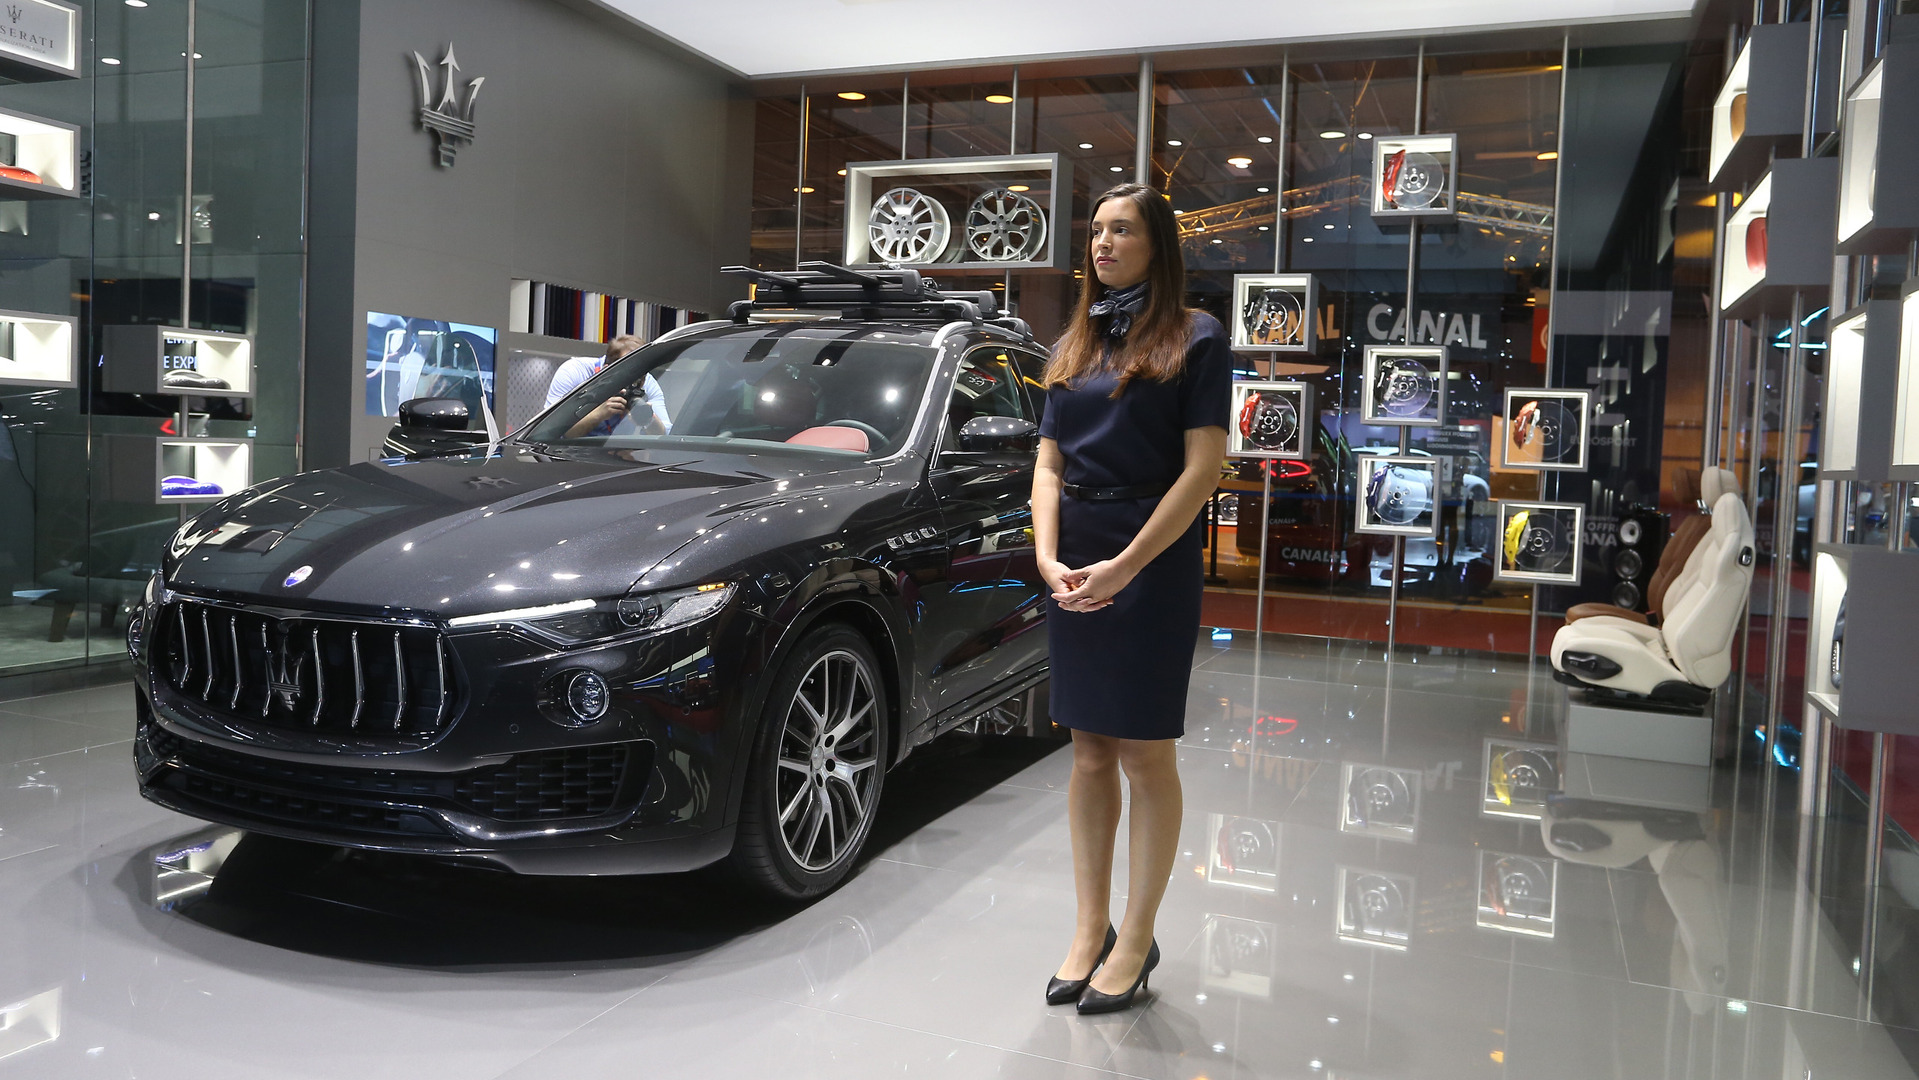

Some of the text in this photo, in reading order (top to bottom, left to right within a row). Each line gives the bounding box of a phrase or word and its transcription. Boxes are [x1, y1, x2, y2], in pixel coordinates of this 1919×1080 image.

[1367, 303, 1487, 349] CANAL
[1570, 435, 1637, 446] EOSPORT
[1281, 547, 1340, 563] CANAL+
